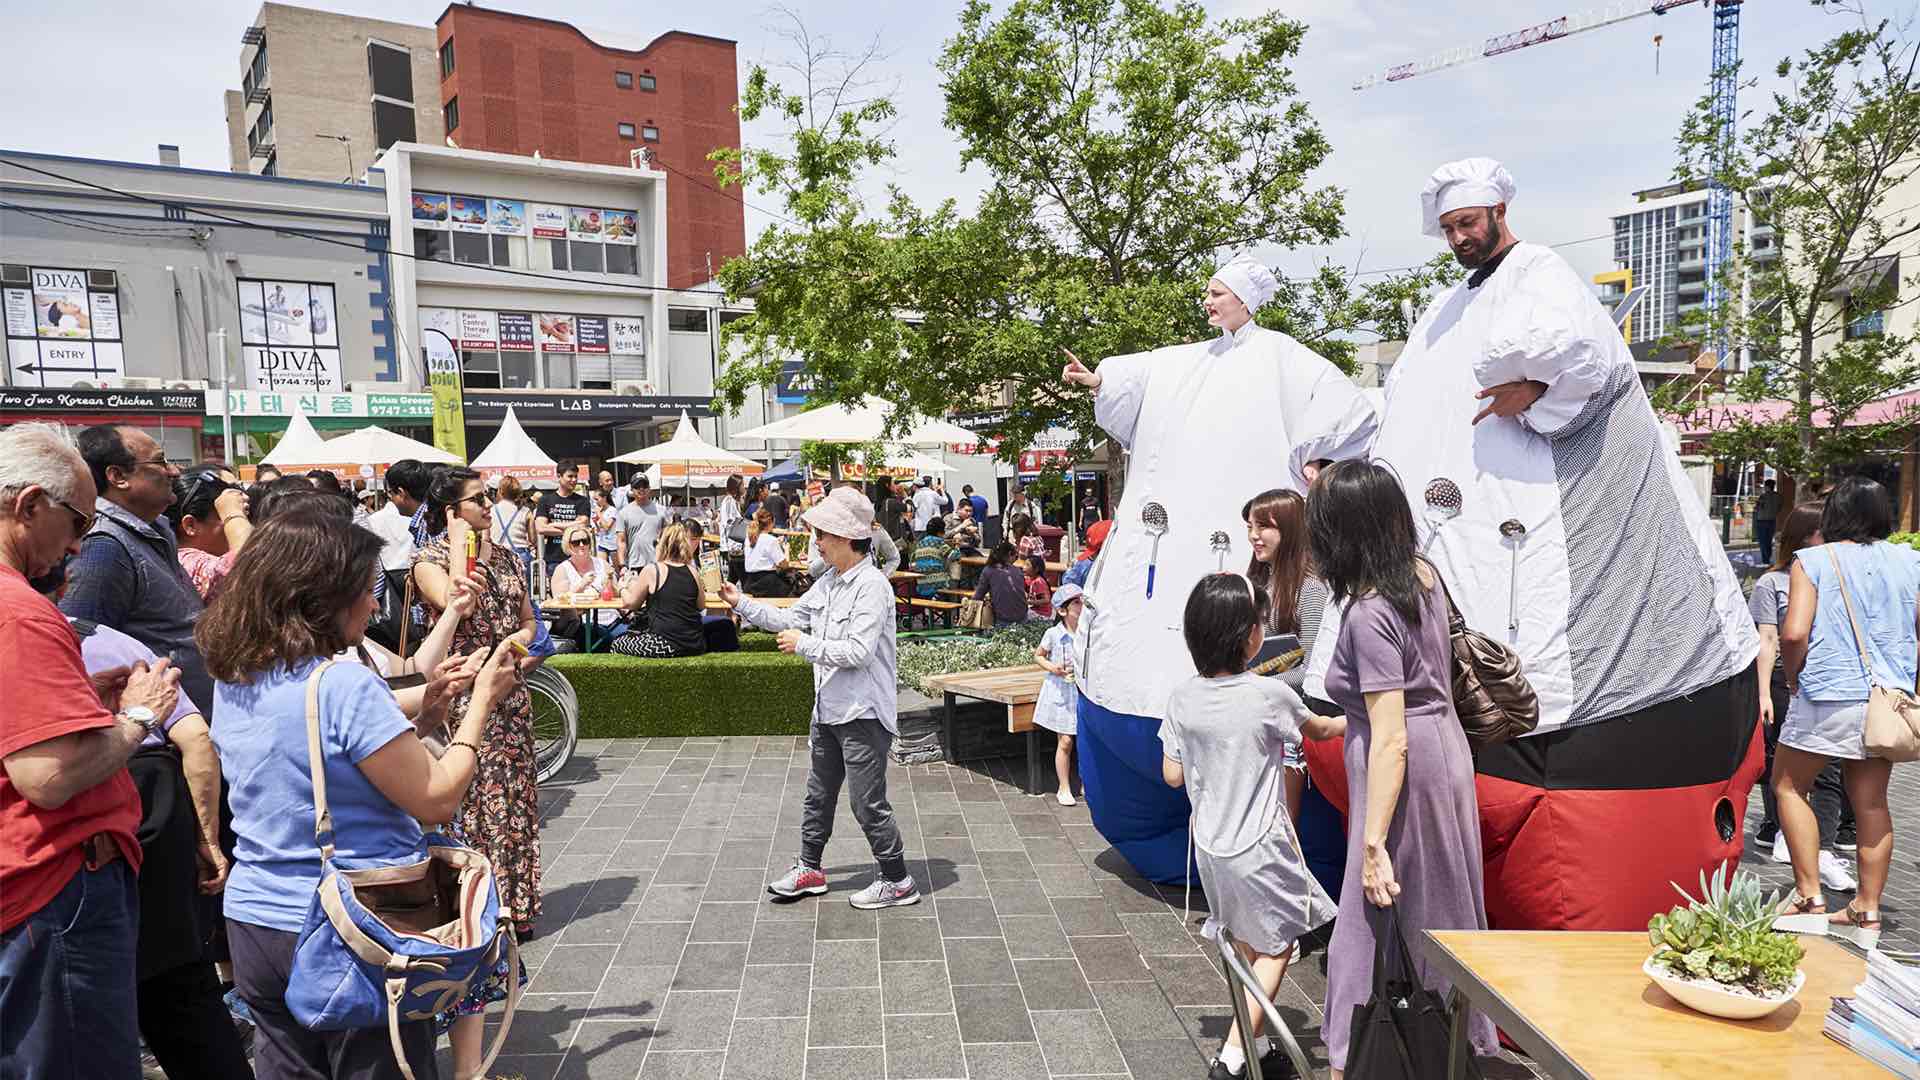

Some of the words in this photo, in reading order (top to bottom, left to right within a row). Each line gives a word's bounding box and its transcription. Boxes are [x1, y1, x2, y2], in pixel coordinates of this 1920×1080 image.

[36, 273, 83, 288] DIVA
[463, 325, 490, 334] Therapy
[49, 349, 85, 360] ENTRY
[258, 350, 327, 371] DIVA
[0, 393, 21, 404] Two
[25, 393, 53, 406] Two
[57, 394, 104, 407] Korean
[107, 395, 154, 407] Chicken
[370, 396, 398, 404] Asian
[560, 399, 592, 411] LAB
[1034, 439, 1074, 449] NEWSAG
[530, 467, 552, 477] Cane
[686, 465, 718, 475] regano
